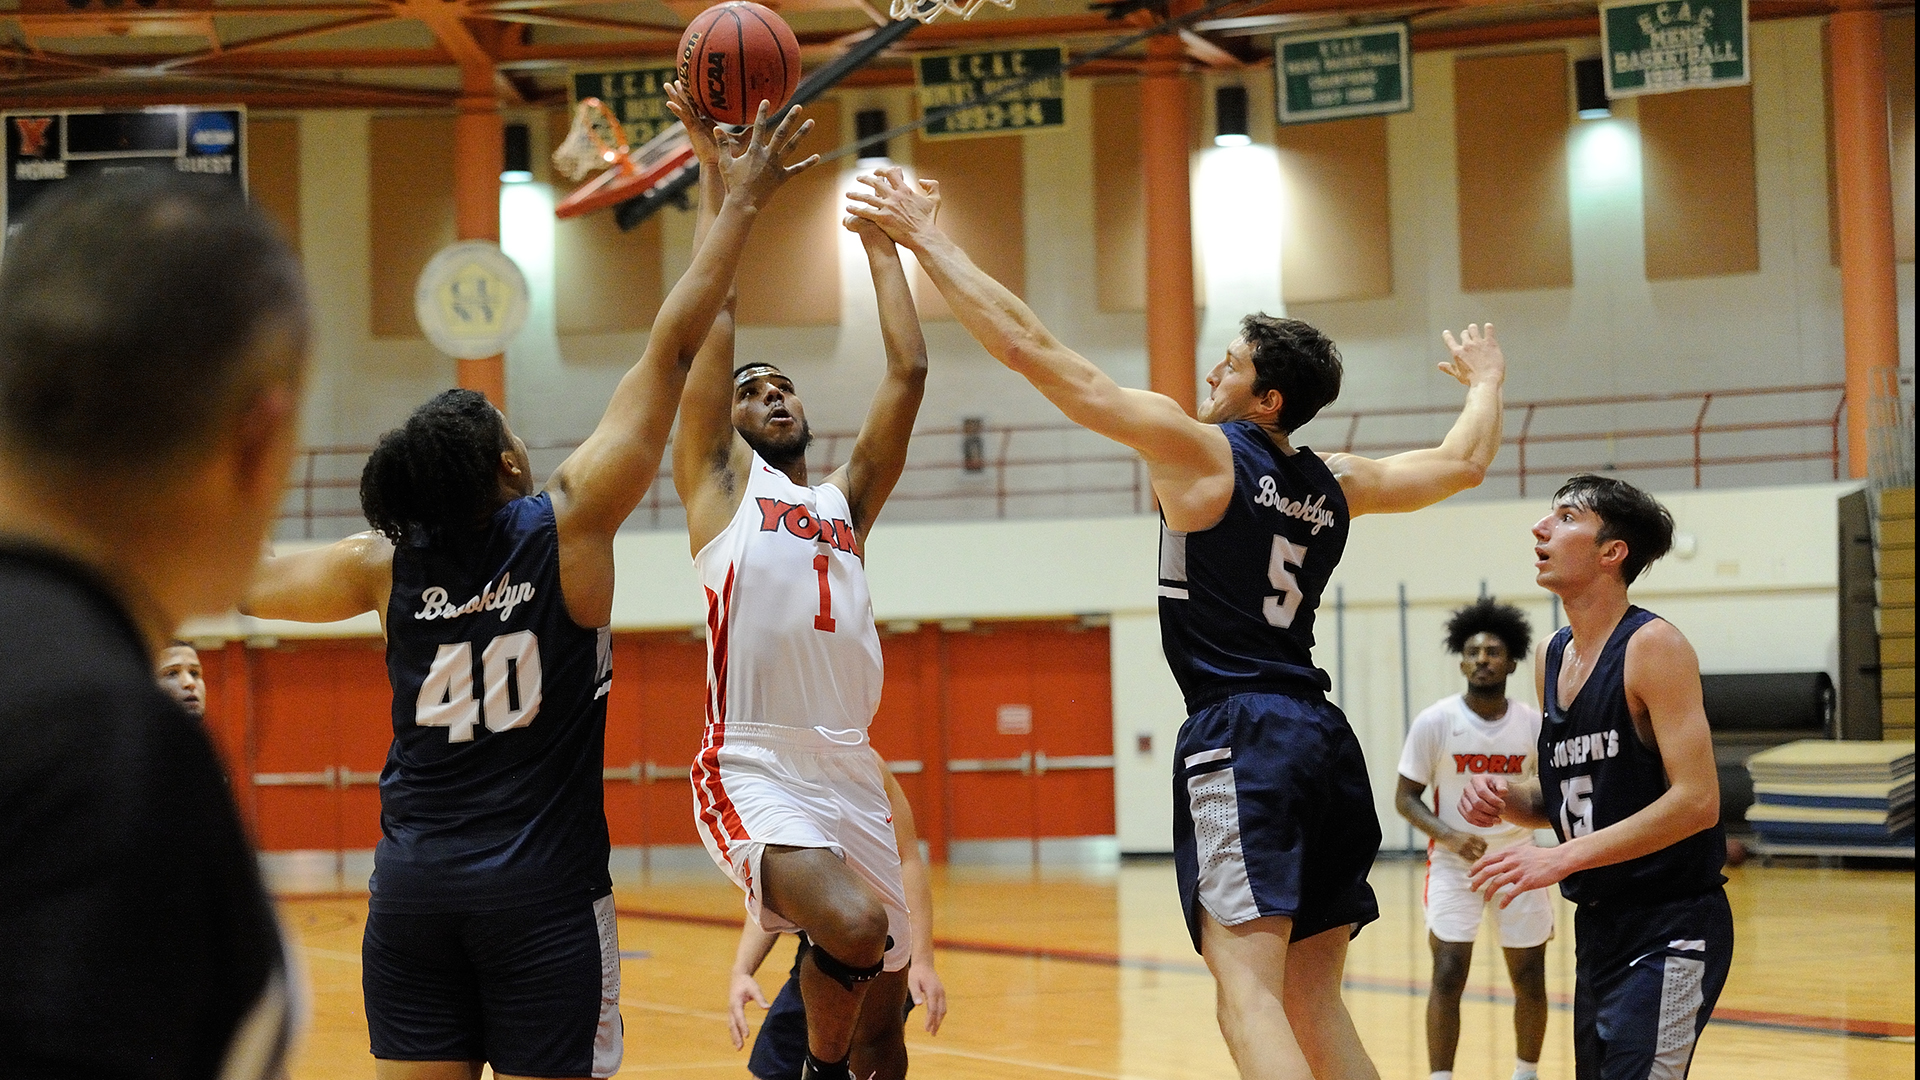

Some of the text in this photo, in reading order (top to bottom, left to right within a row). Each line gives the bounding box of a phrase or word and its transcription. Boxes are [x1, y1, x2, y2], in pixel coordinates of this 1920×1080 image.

[707, 52, 729, 111] NCAA
[1615, 40, 1739, 74] BASKETBALL
[755, 497, 861, 558] YORK
[1254, 475, 1335, 536] Brooklyn
[813, 554, 836, 633] 1
[1262, 534, 1308, 629] 5
[415, 629, 543, 743] 40
[1453, 754, 1526, 774] YORK
[1554, 729, 1619, 768] JOSEPH'S
[1560, 775, 1594, 841] 15
